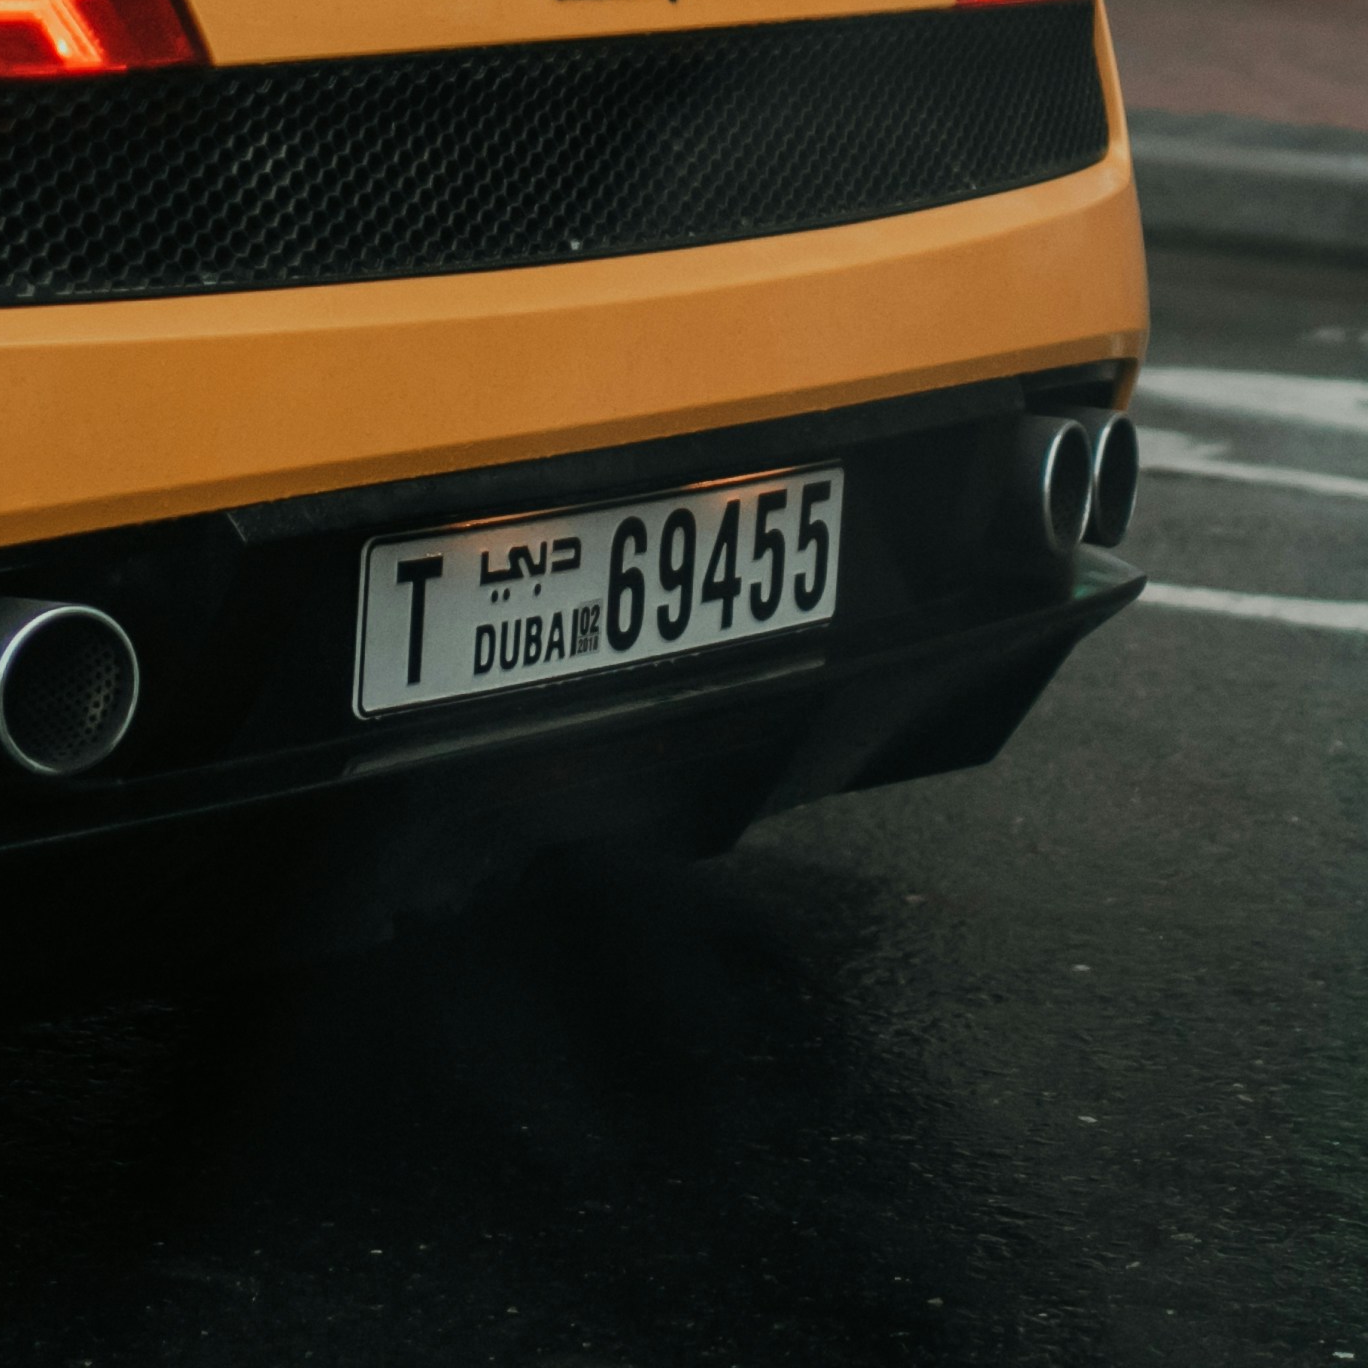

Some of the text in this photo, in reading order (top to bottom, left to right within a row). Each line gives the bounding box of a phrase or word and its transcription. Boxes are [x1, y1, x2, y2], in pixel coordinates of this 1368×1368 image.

[480, 536, 581, 603] دبي
[606, 480, 831, 652] 69455
[397, 554, 444, 686] T
[473, 608, 579, 676] DUBAI
[580, 604, 600, 635] 02
